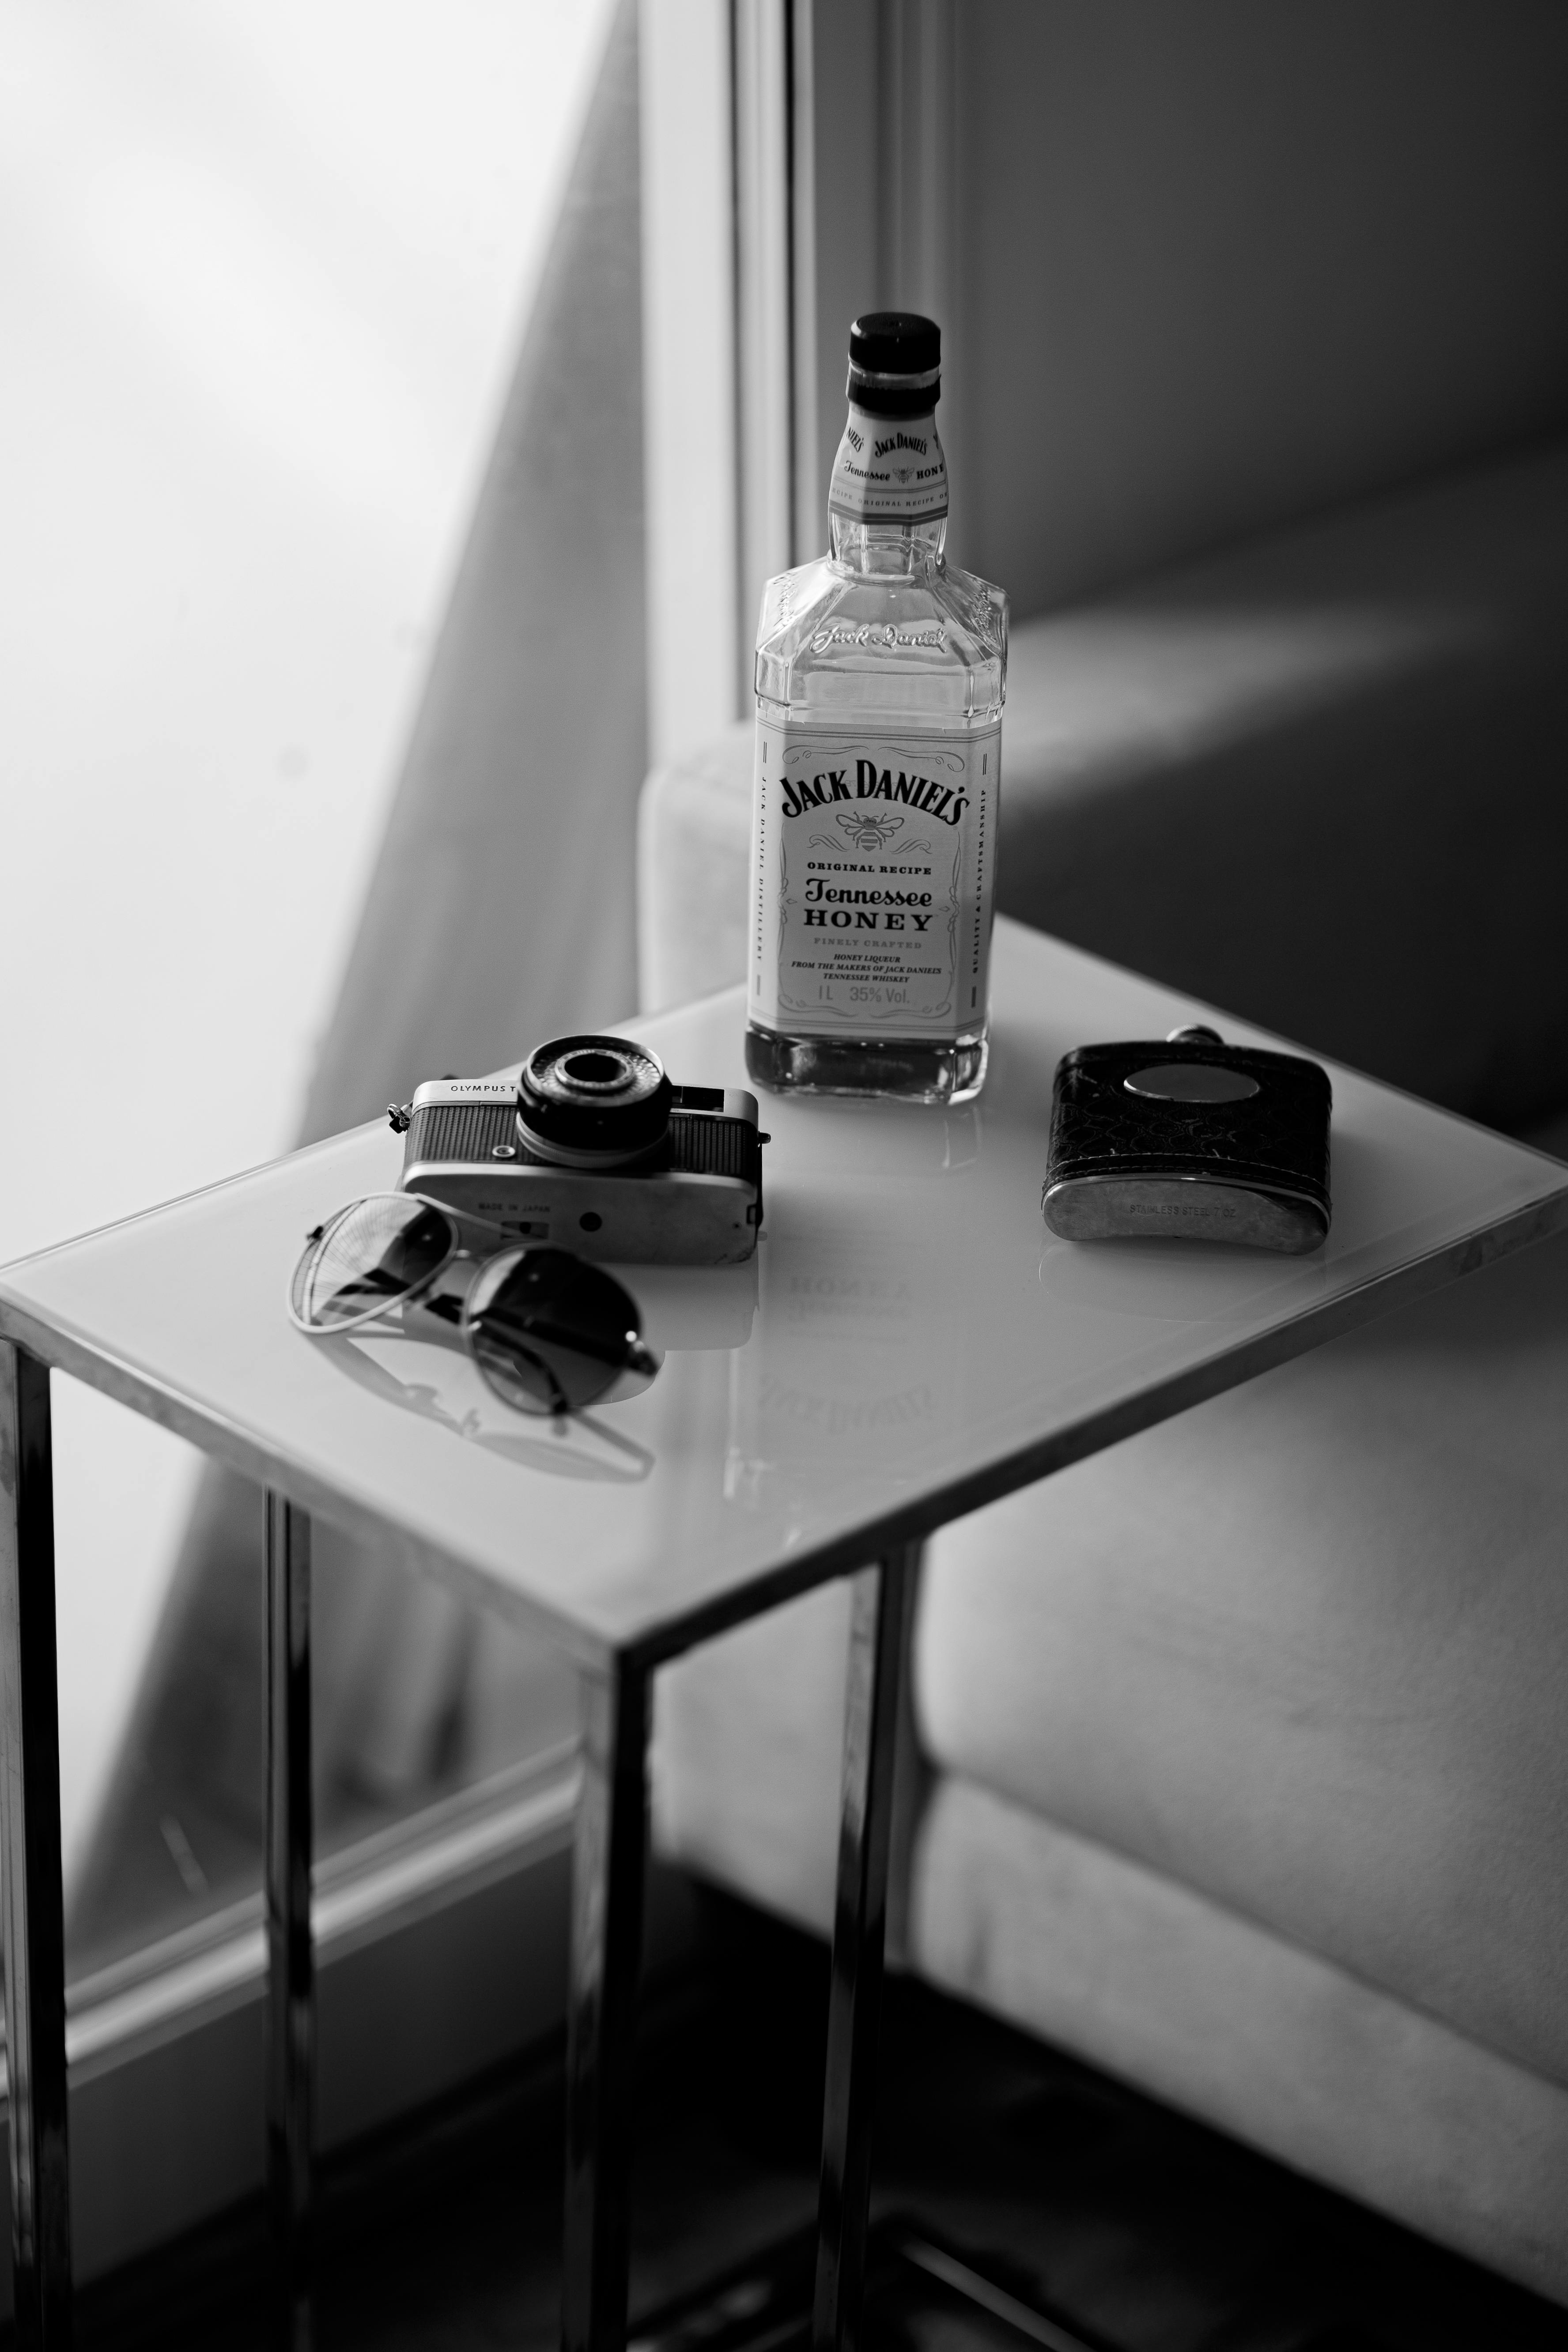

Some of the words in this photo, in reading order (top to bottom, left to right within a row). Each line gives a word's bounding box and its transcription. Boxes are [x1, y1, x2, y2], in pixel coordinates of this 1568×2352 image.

[846, 427, 864, 453] NIEL'S
[875, 437, 896, 458] JACK
[897, 432, 927, 456] DANIEL'S
[844, 460, 891, 481] Tennessee
[917, 464, 944, 480] HONE
[858, 498, 901, 507] ORIGINAL
[906, 497, 934, 507] RECIPE
[779, 770, 854, 818] JACK
[854, 759, 971, 826] DANIEL'S
[976, 790, 986, 900] CRAFTSMANSHIP
[807, 862, 875, 873] ORIGINAL
[879, 866, 932, 875] RECIPE
[805, 878, 932, 907] Tennessee
[803, 908, 933, 931] HONEY
[814, 937, 859, 946] FINELY
[863, 940, 922, 949] CRAFTED
[791, 960, 815, 969] FROM
[833, 953, 864, 962] HONEY
[864, 955, 901, 964] LIQUEUR
[823, 972, 870, 981] TENNESSEE
[872, 974, 910, 983] WHISKEY
[849, 986, 882, 1002] 35%
[885, 987, 910, 1003] Vol.
[1130, 1204, 1180, 1215] STAINLESS
[1182, 1206, 1211, 1217] STEEL
